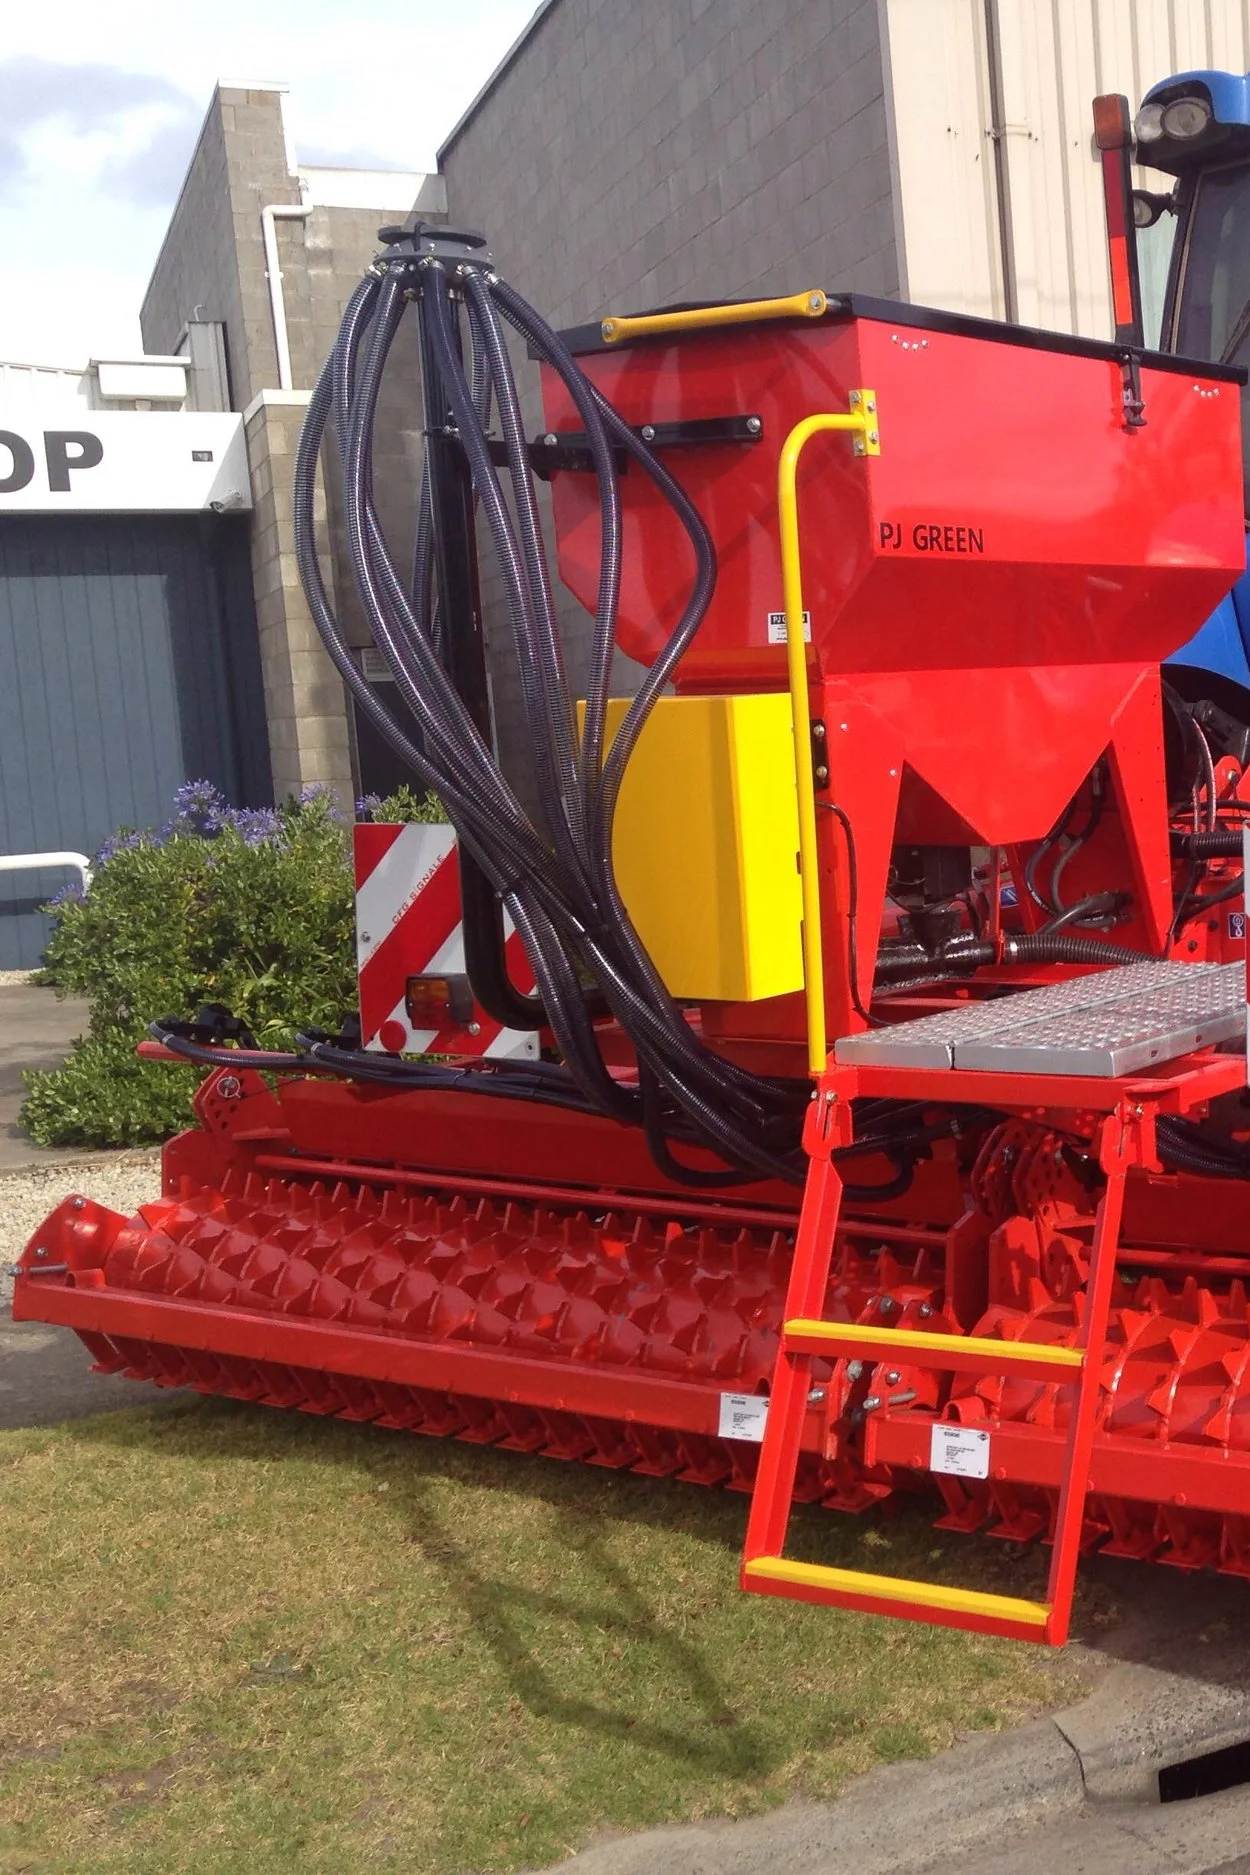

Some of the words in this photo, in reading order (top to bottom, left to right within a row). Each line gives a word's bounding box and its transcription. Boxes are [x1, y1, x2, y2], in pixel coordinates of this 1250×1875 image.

[879, 522, 902, 549] PJ
[912, 524, 984, 553] GREEN
[392, 902, 409, 925] CFG
[409, 854, 444, 901] SIGNALE
